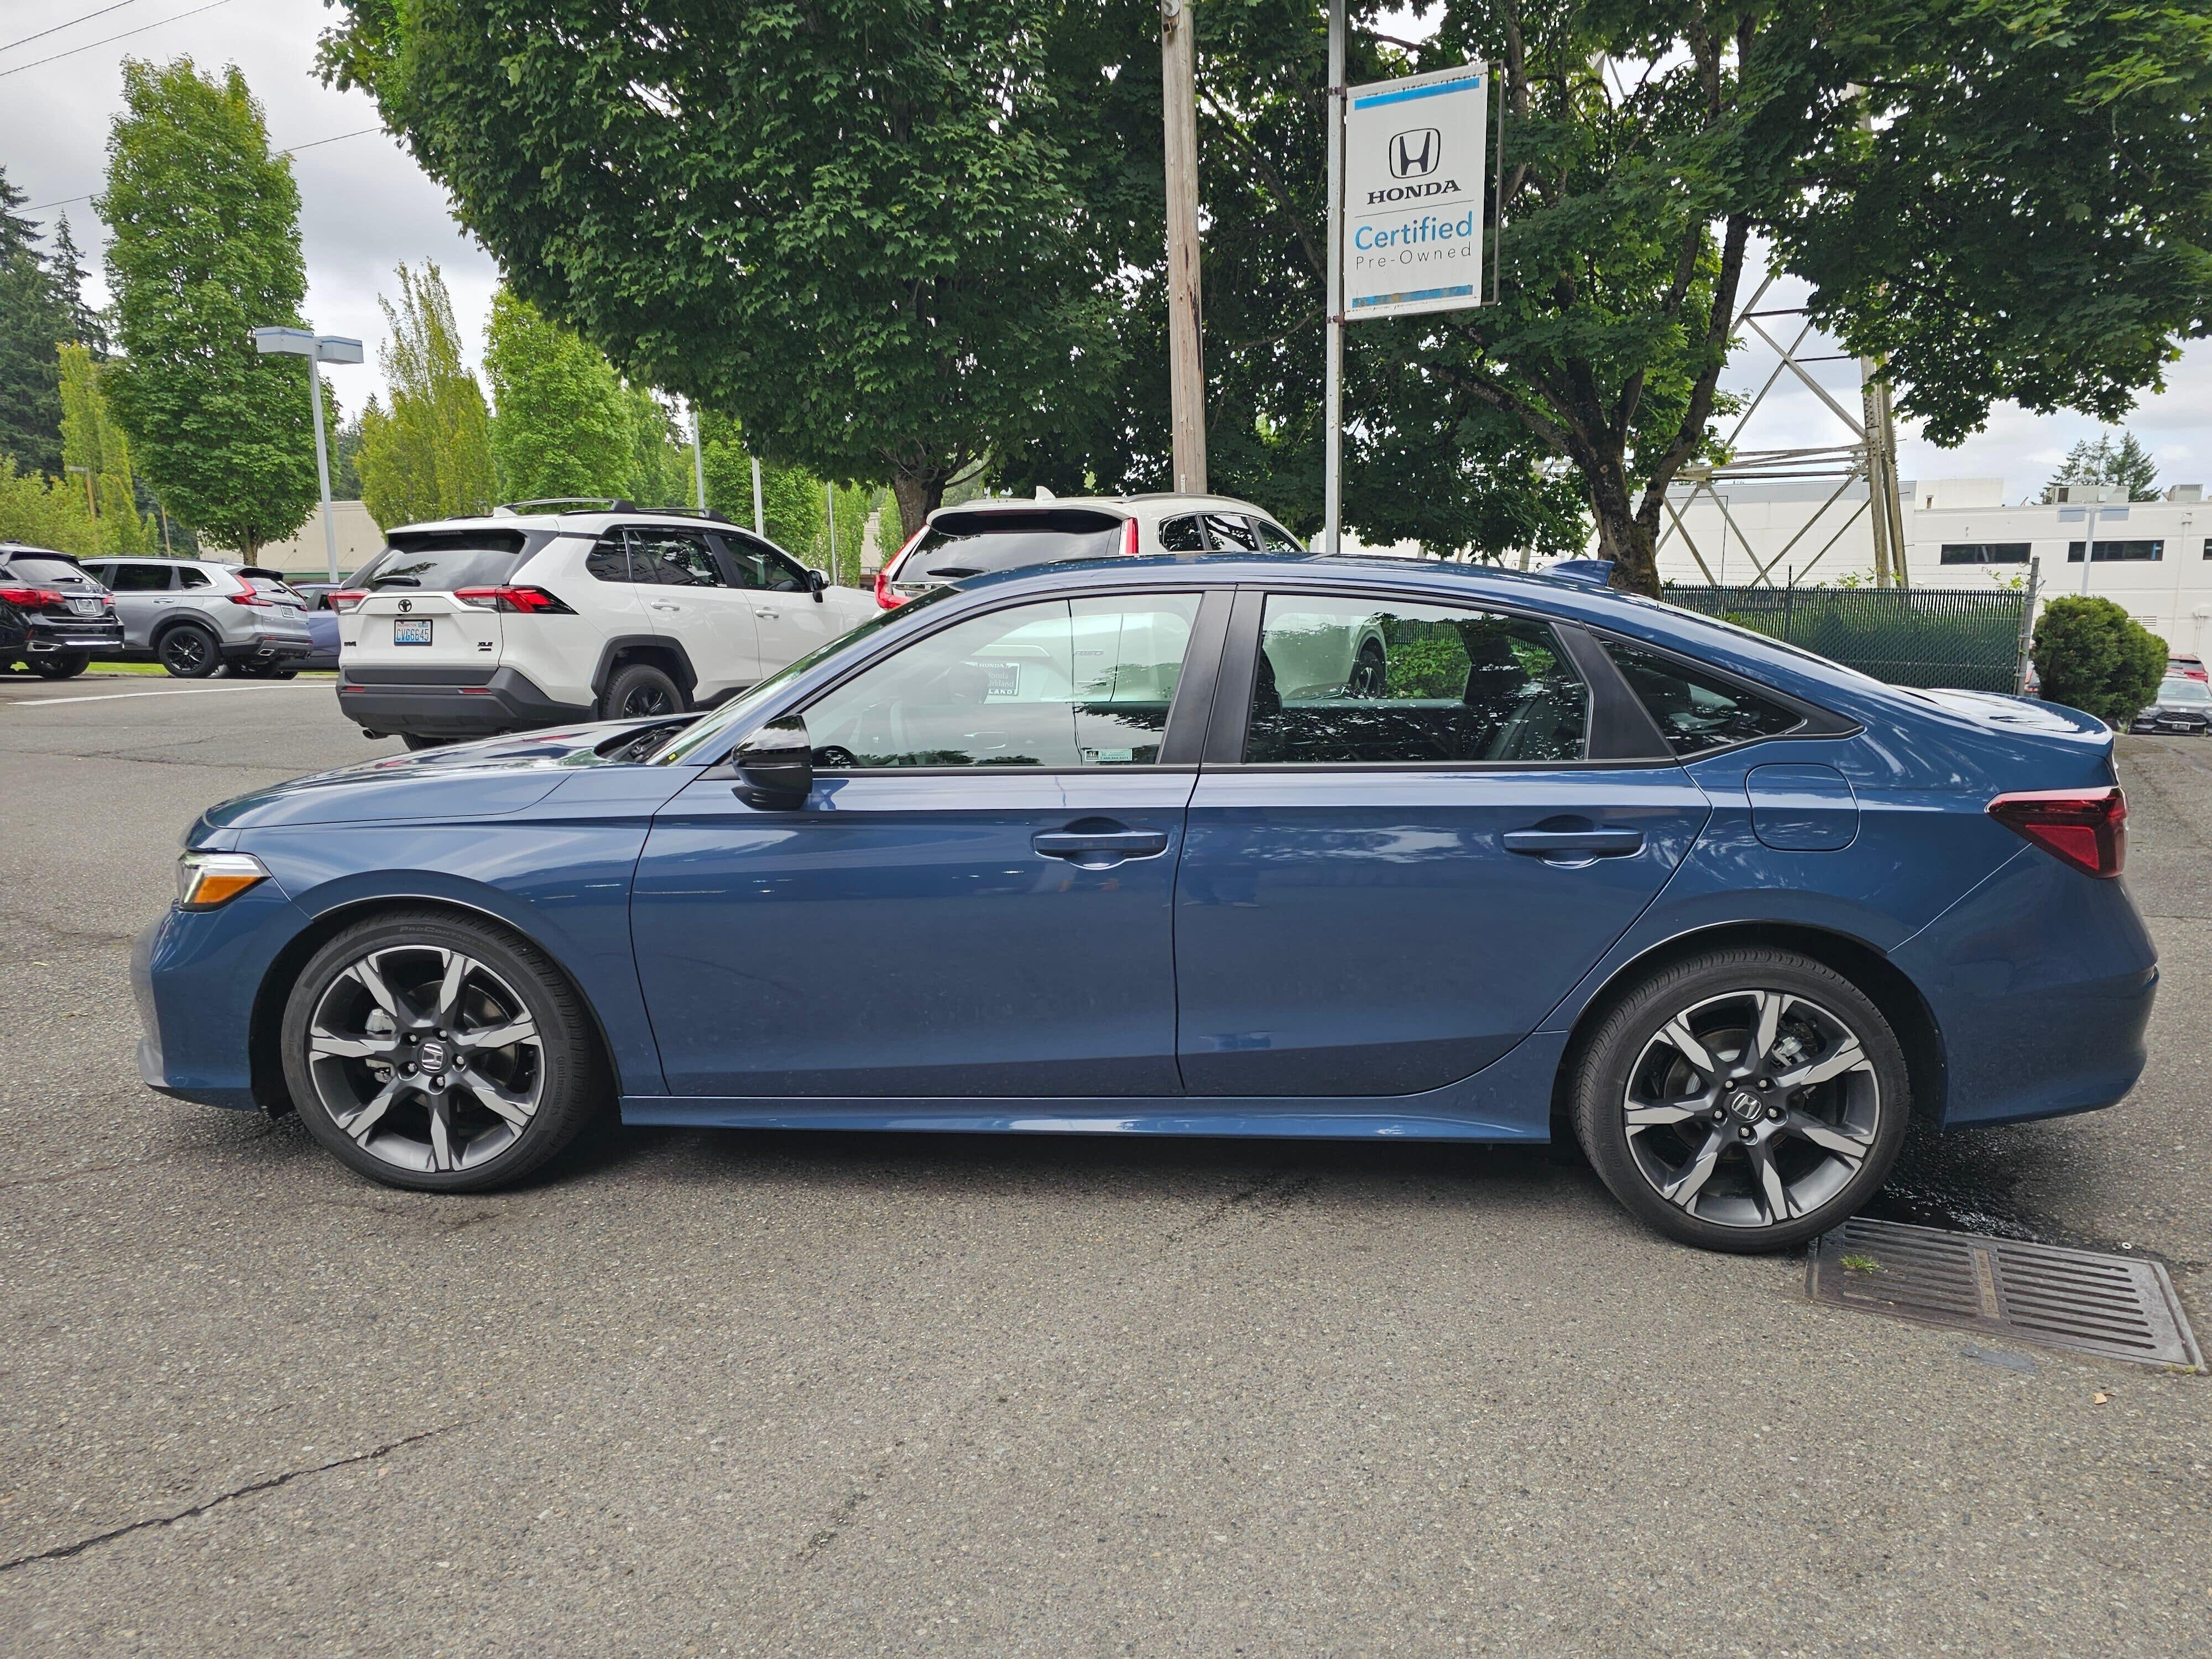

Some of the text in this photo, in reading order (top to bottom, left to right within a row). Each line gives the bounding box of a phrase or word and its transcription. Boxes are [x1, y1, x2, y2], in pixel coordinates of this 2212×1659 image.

[1367, 179, 1462, 205] HONDA
[1354, 210, 1473, 251] Certified
[1356, 241, 1472, 270] Pre-Owned
[397, 629, 429, 641] CVG6645
